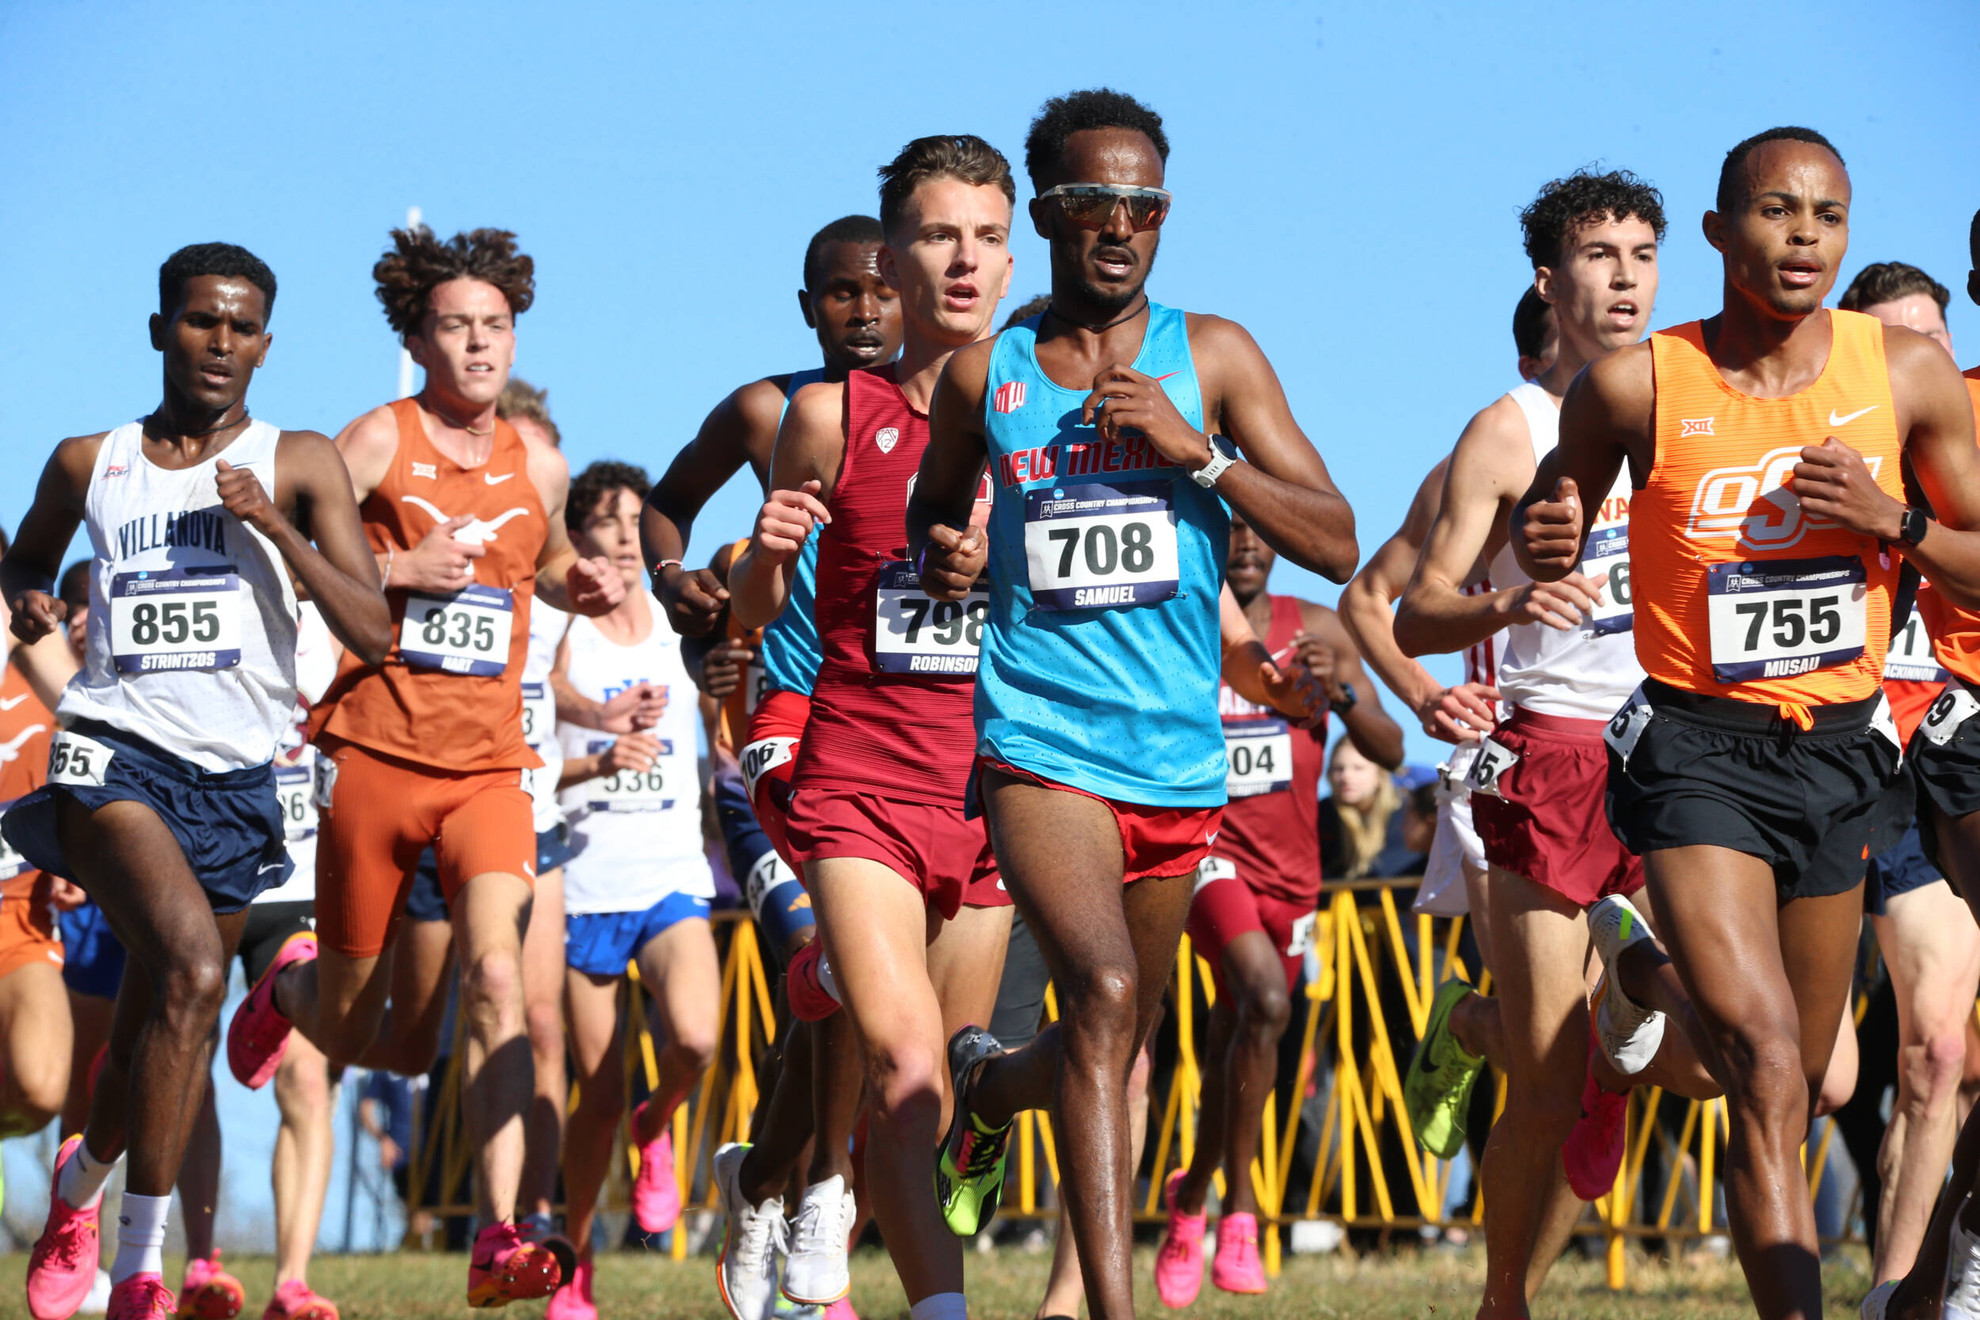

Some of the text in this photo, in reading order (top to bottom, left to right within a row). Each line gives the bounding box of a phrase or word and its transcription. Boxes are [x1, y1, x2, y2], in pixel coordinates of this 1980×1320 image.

[999, 445, 1060, 488] NEW
[1066, 436, 1186, 477] MEXI
[1053, 503, 1075, 511] CROSS
[1075, 500, 1106, 509] COUNTRY
[1106, 496, 1158, 507] CHAMPIONSHIPS
[1684, 446, 1884, 550] OS
[118, 509, 227, 561] VILLANOVA
[1048, 522, 1154, 578] 708
[1074, 586, 1136, 606] SAMUEL
[132, 601, 220, 645] 855
[422, 608, 494, 652] 835
[900, 599, 989, 646] 798
[1736, 596, 1841, 651] 755
[141, 652, 216, 670] STRINTZOS
[1763, 656, 1820, 678] MUSAU
